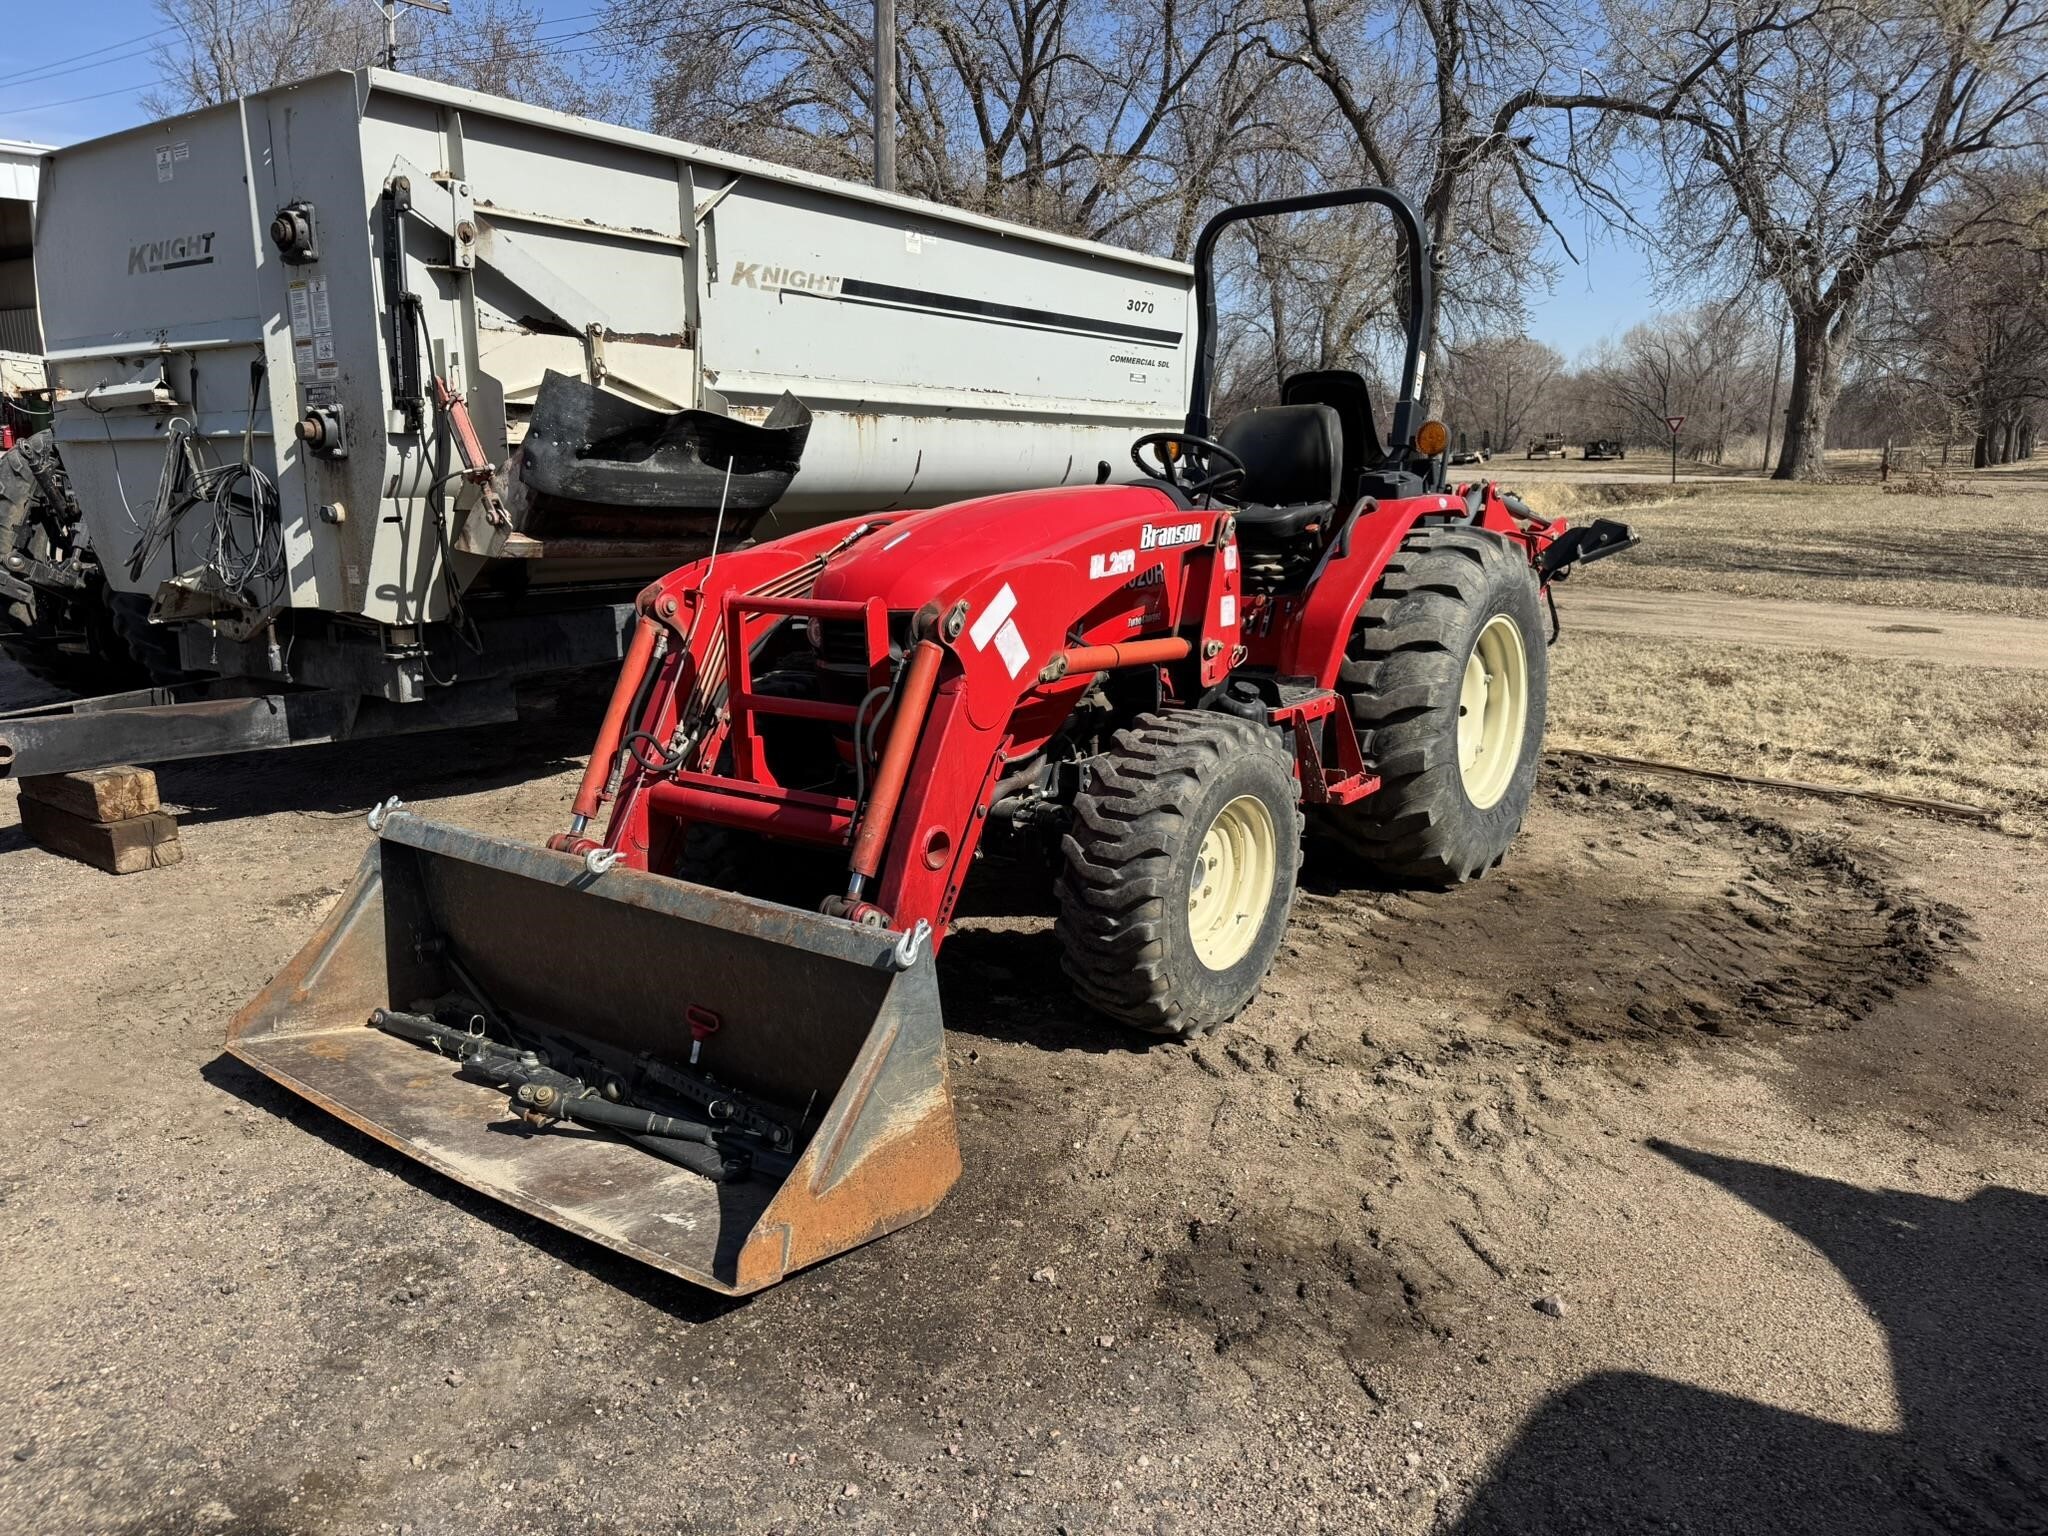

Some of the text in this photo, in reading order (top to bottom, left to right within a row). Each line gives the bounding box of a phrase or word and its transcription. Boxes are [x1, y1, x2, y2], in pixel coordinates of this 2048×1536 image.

[128, 232, 215, 275] KNIGHT
[730, 261, 840, 293] KNIGHT
[1127, 299, 1154, 314] 3070
[1110, 354, 1155, 367] COMMERCIAL
[1140, 523, 1202, 550] Branson
